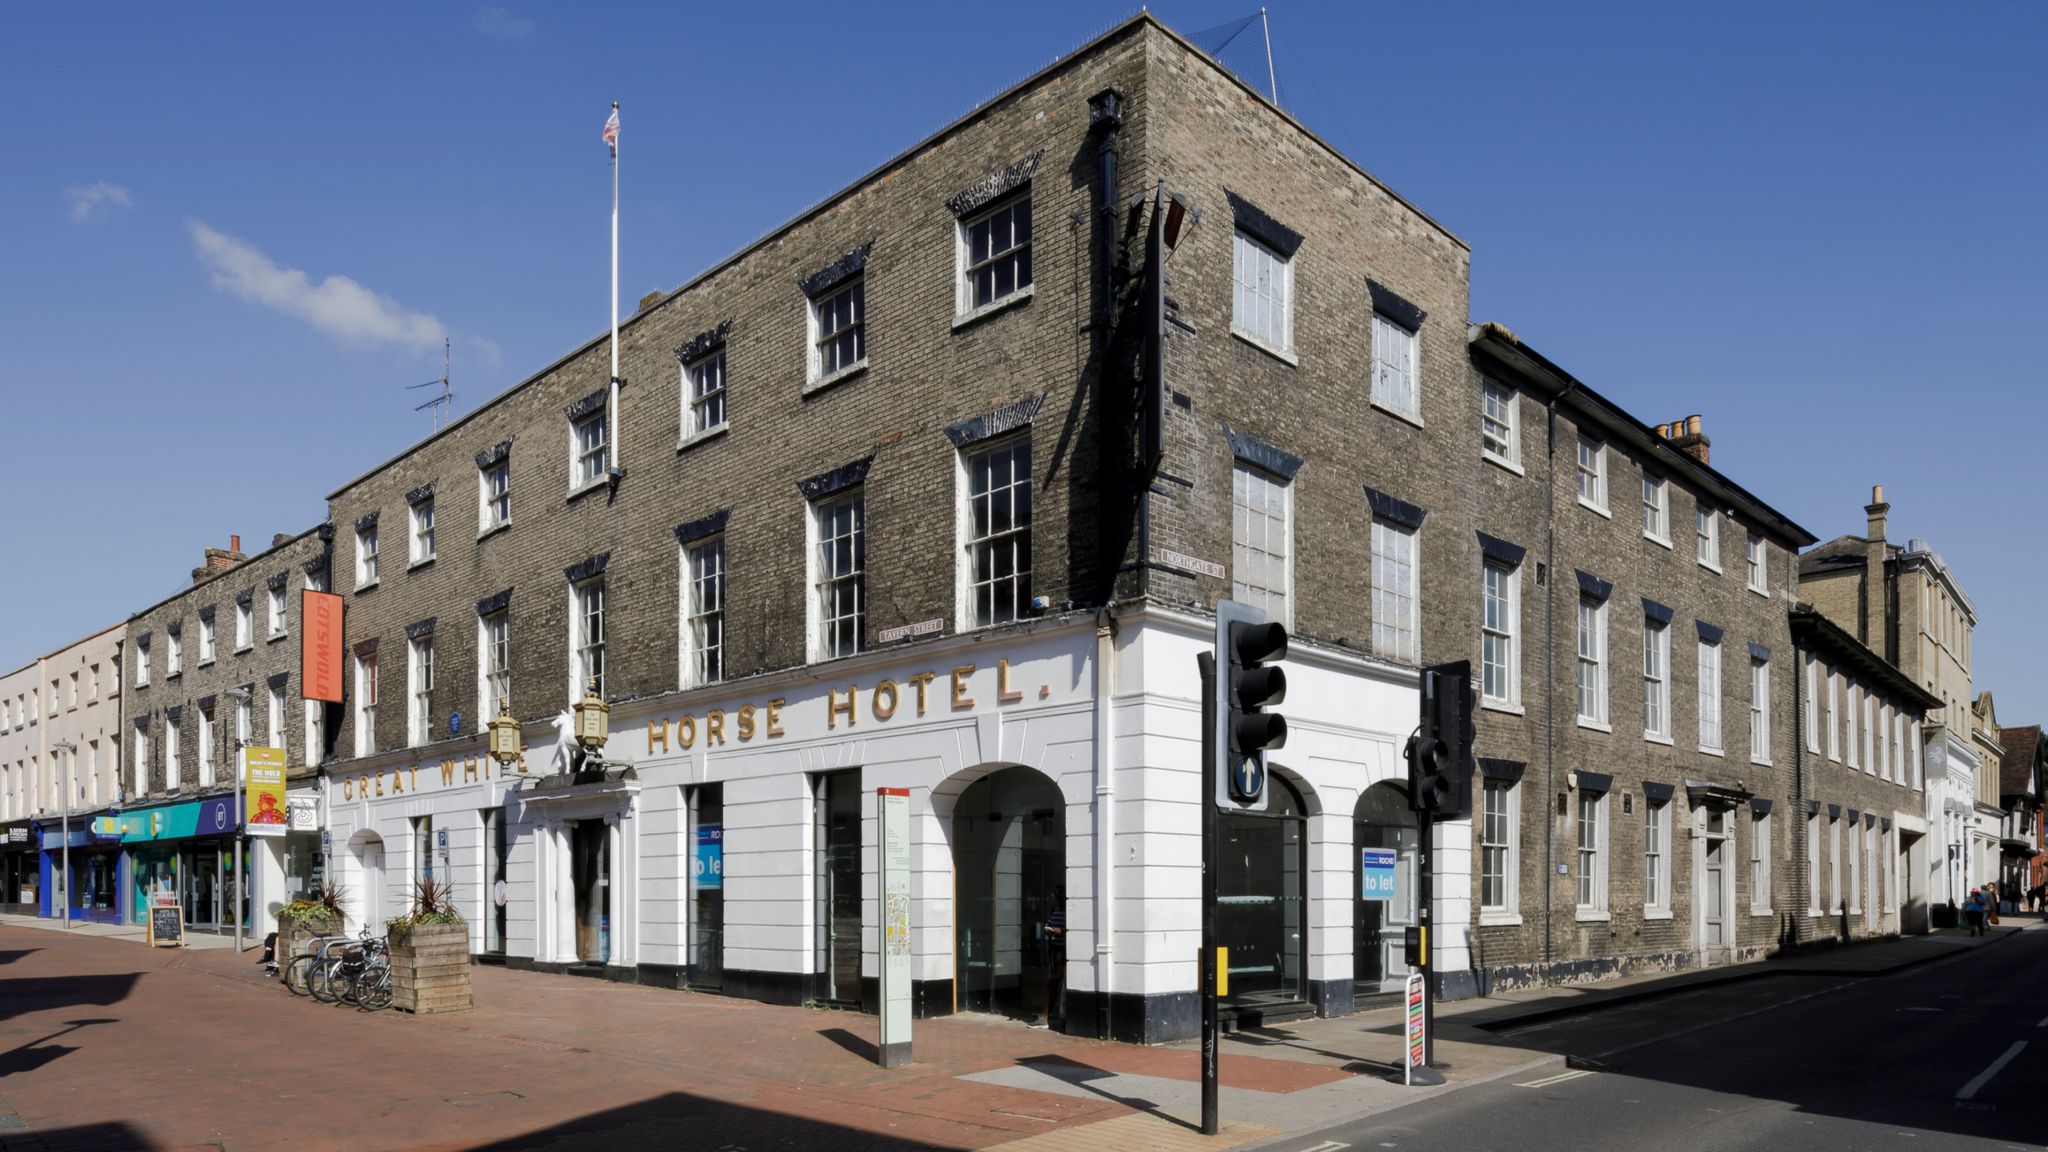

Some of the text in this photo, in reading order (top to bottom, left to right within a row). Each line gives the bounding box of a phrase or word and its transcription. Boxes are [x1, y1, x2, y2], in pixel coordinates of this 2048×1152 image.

[1166, 552, 1221, 576] NORTHGATE ST
[884, 621, 938, 640] TAVERN STREET
[317, 595, 329, 698] COTSWOLD
[343, 764, 420, 801] GREAT
[440, 744, 529, 787] WHIE
[648, 698, 786, 754] HORSE
[252, 768, 264, 776] THE
[1365, 874, 1394, 891] to let
